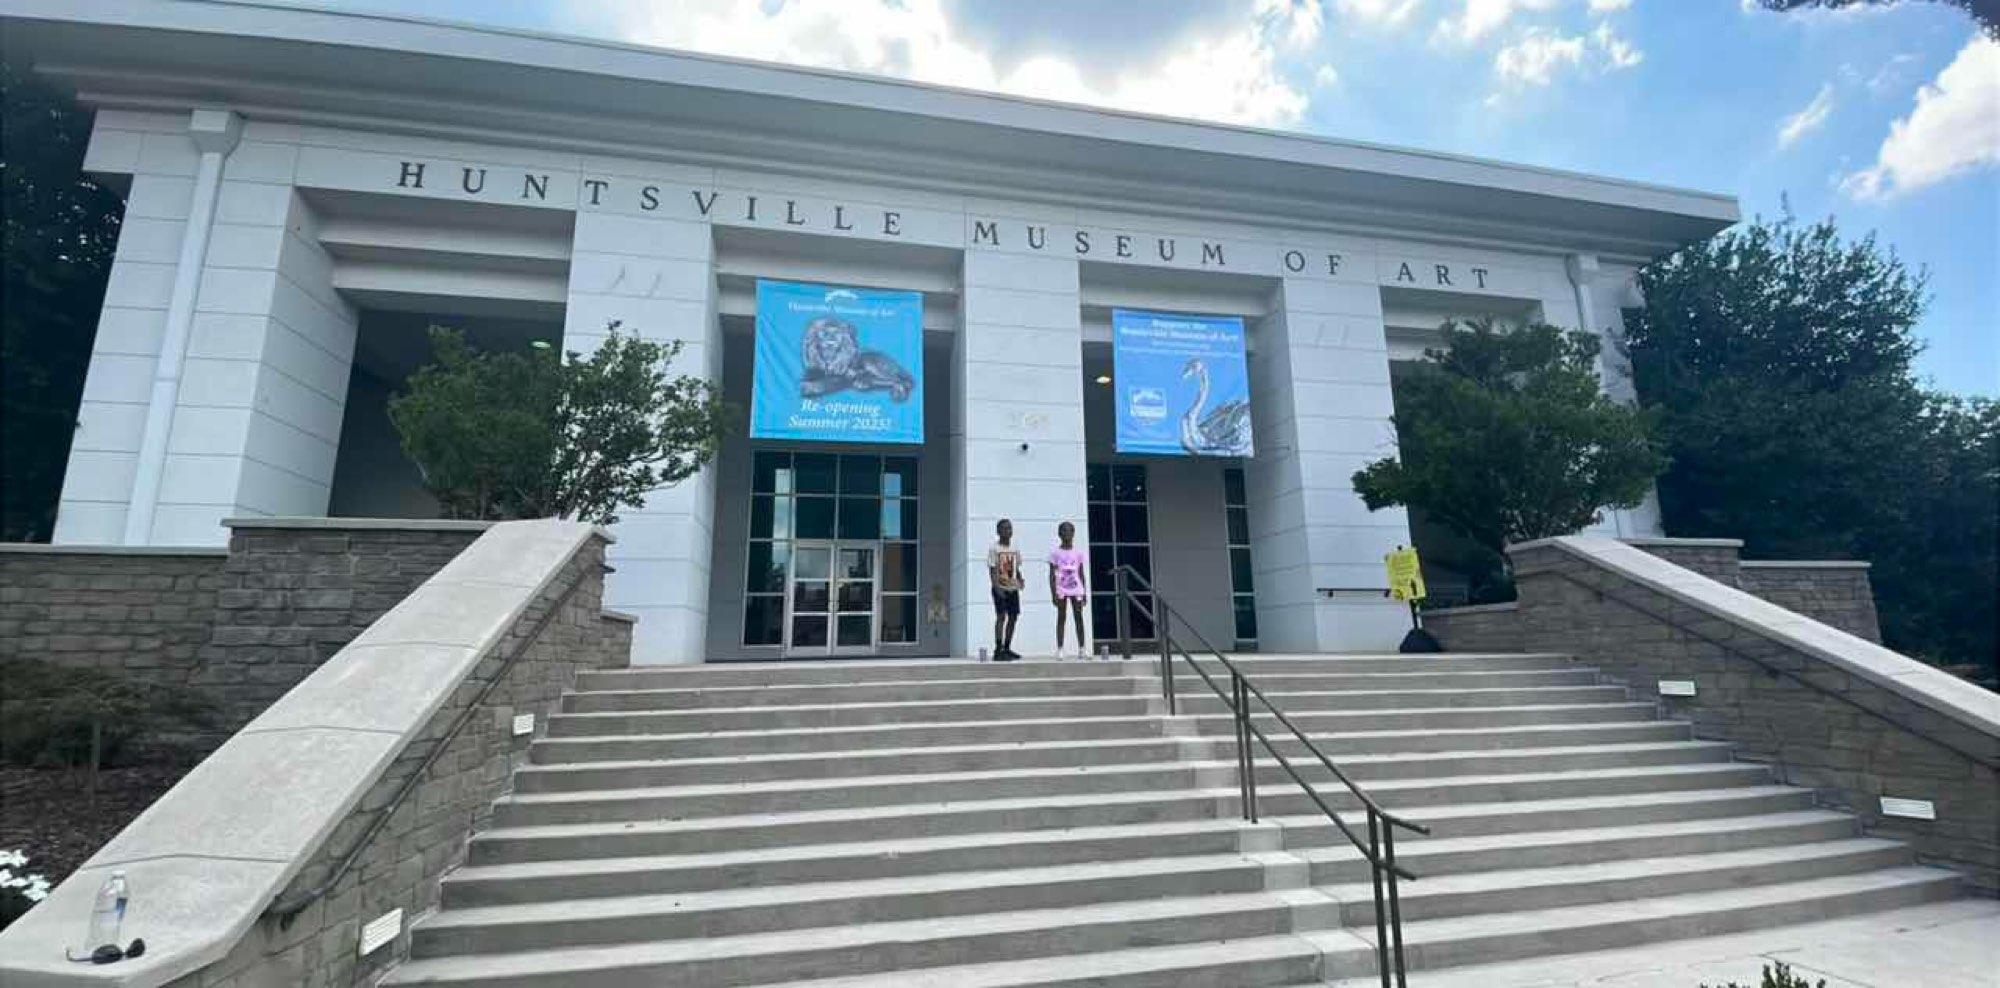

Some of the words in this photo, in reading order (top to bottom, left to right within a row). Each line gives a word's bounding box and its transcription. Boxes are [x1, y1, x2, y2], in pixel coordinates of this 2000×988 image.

[397, 161, 902, 235] HUNTSVILLE
[973, 220, 1226, 266] MUSEUM
[1285, 250, 1343, 276] OF
[1396, 261, 1489, 289] ART
[800, 399, 882, 417] Re-opening
[788, 415, 848, 429] Summer
